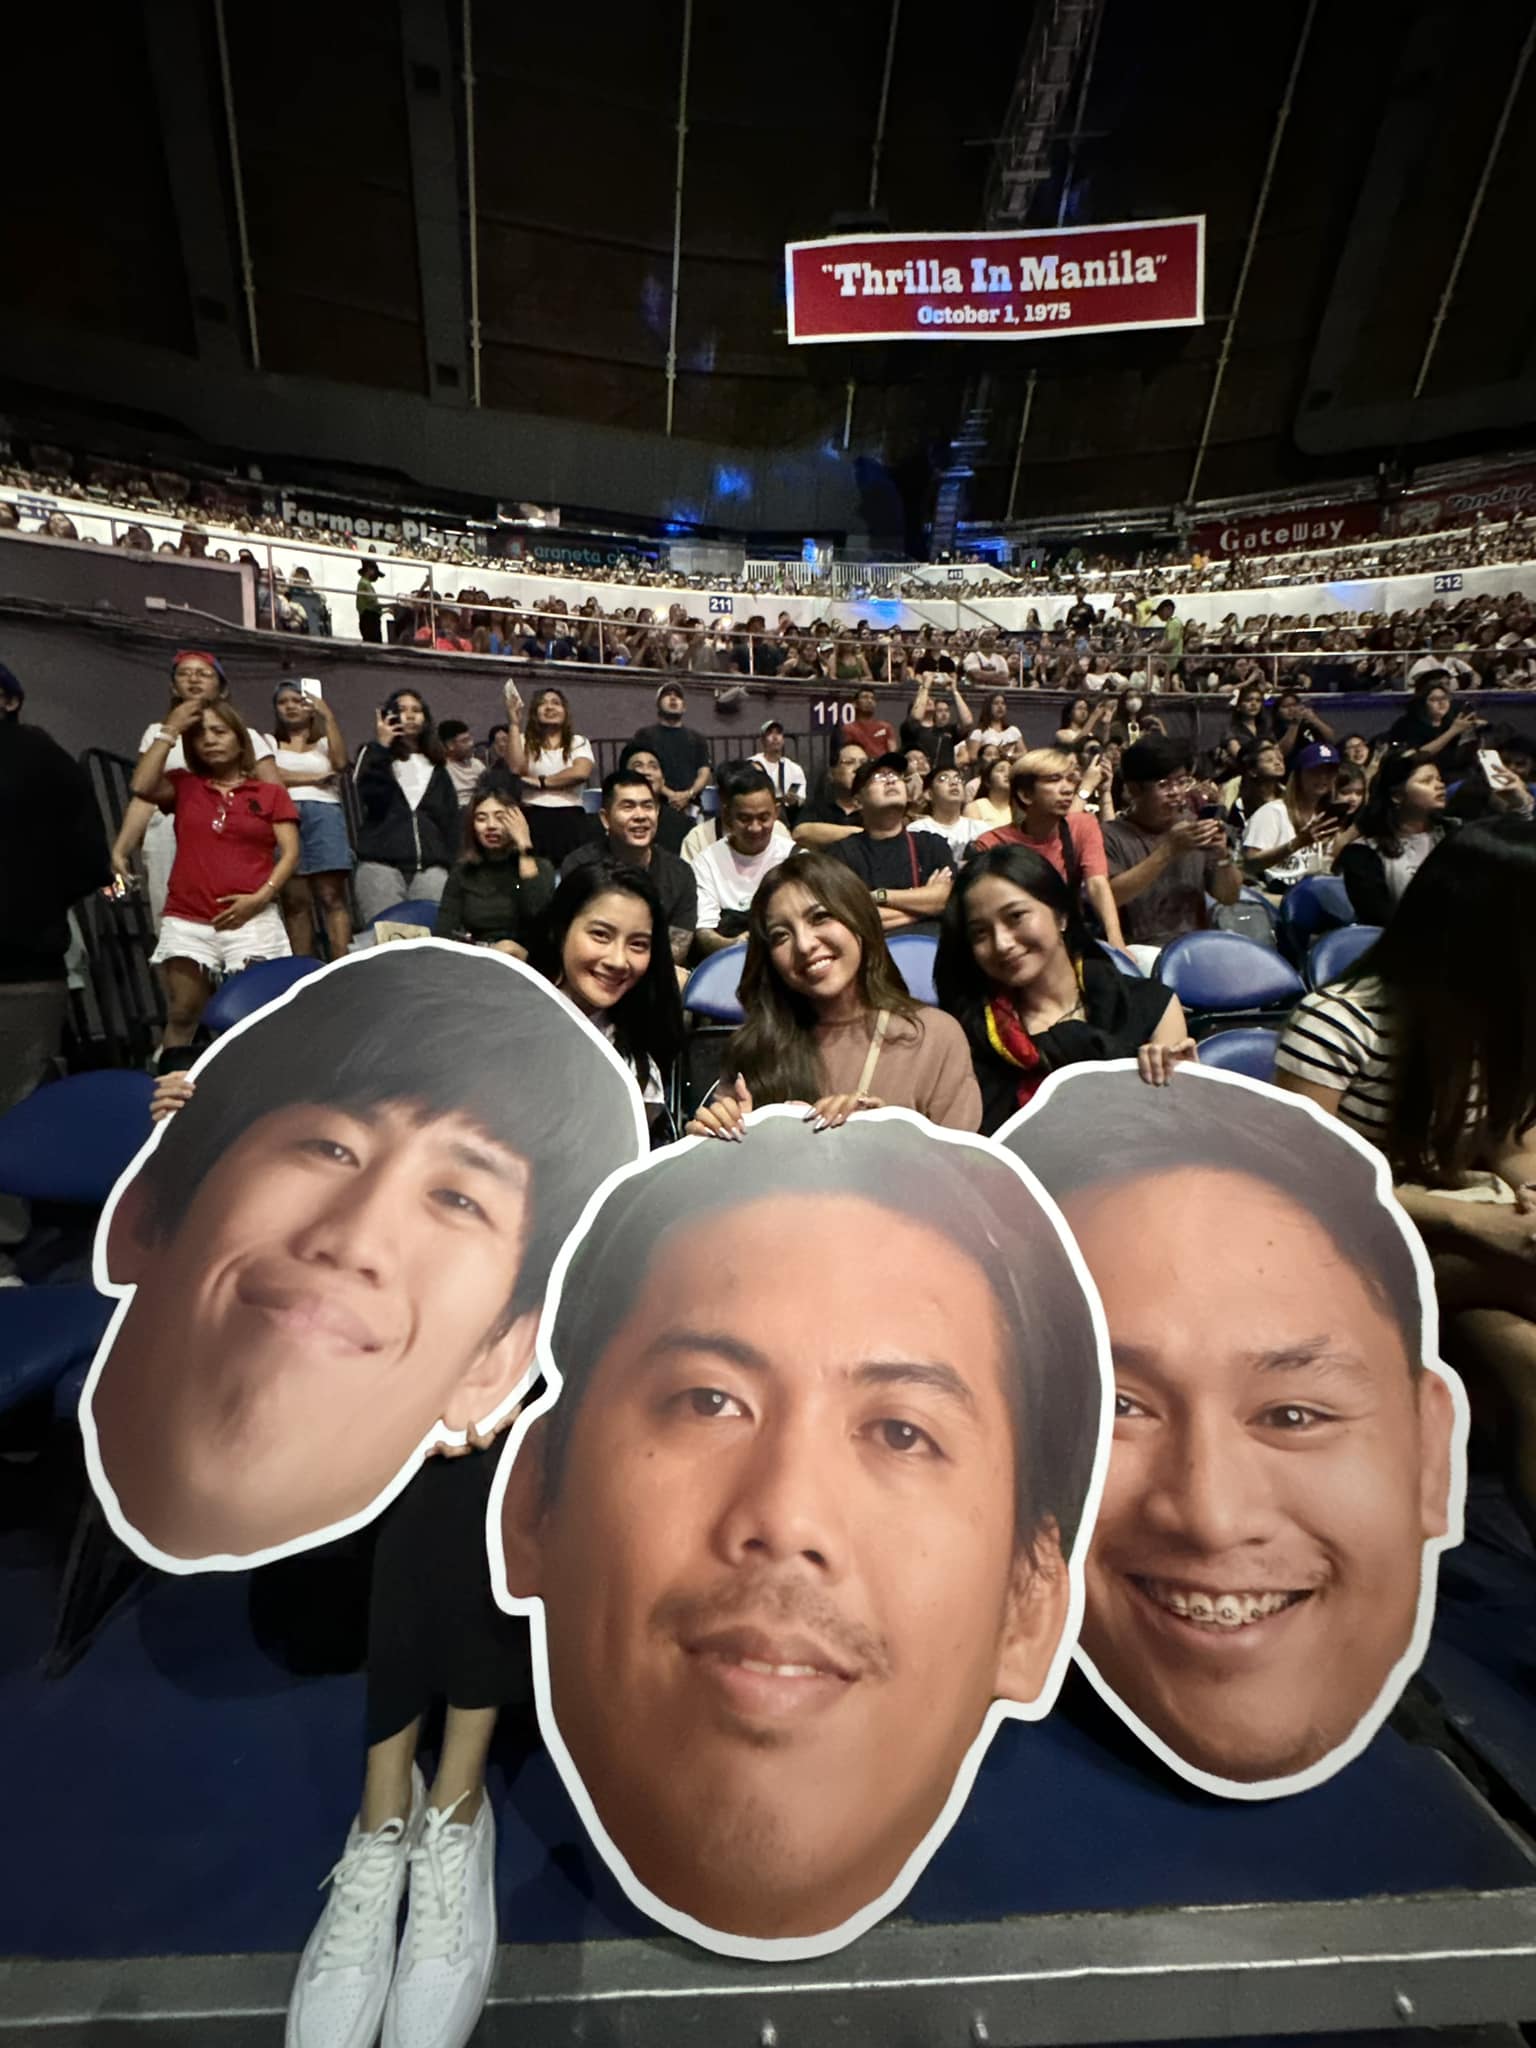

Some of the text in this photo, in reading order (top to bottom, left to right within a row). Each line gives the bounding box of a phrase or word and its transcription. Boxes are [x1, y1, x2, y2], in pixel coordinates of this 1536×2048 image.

[821, 250, 1168, 297] "Thrilla In Manila"
[918, 303, 1071, 326] October 1, 1975
[282, 501, 399, 541] Farmers
[533, 546, 602, 565] araneta
[1436, 576, 1462, 590] 212
[711, 598, 732, 611] 211
[813, 701, 856, 726] 110
